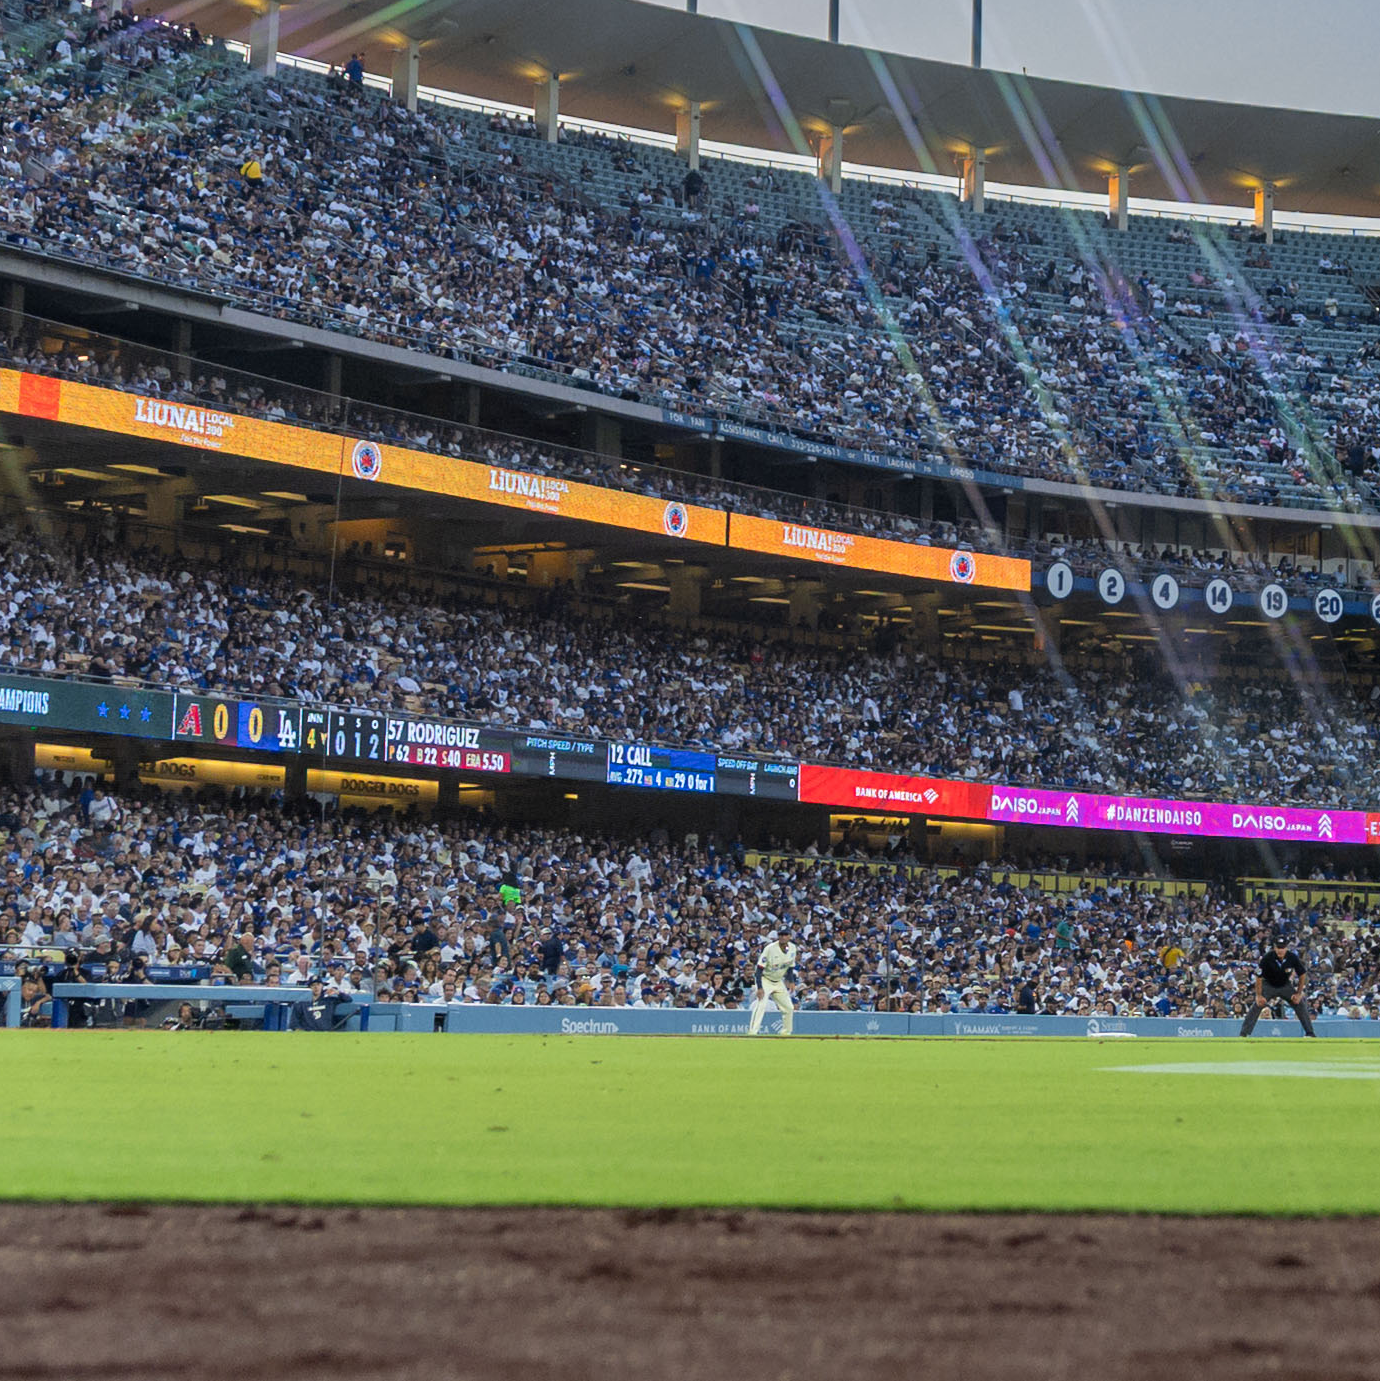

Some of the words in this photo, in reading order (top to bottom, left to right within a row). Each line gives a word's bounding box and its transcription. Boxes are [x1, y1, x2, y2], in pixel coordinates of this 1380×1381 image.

[134, 399, 206, 435] LiUNA!
[206, 412, 235, 428] LOCAL
[1056, 571, 1064, 591] 1
[1106, 576, 1118, 596] 2
[1159, 581, 1171, 601] 4
[1210, 587, 1228, 607] 14
[1265, 590, 1284, 611] 19
[1318, 596, 1340, 616] 20
[214, 703, 229, 740] 0
[248, 707, 263, 743] 0
[277, 710, 296, 748] LA
[388, 720, 404, 740] 57
[407, 723, 480, 748] RODRIGUEZ
[306, 728, 316, 749] 4
[335, 731, 346, 755] 0
[355, 732, 362, 757] 1
[369, 734, 380, 759] 2
[526, 737, 548, 749] PITCH
[548, 739, 571, 751] SPEED
[577, 742, 594, 753] TYPE
[389, 746, 395, 759] P
[396, 746, 410, 762] 62
[424, 748, 437, 764] 22
[448, 750, 461, 767] 40
[466, 753, 481, 768] ERA
[482, 753, 504, 771] 5.50
[610, 744, 624, 764] 12
[626, 746, 652, 767] CALL
[717, 757, 736, 769] SPEED
[160, 761, 196, 778] DOGS
[341, 778, 386, 793] DODGER
[388, 783, 419, 796] DOGS
[623, 768, 643, 785] .272
[655, 771, 662, 787] 4
[674, 773, 686, 789] 29
[687, 774, 694, 790] 0
[709, 776, 714, 792] 1
[855, 786, 877, 799] BANK
[877, 788, 887, 800] OF
[887, 790, 922, 803] AMERICA
[1038, 807, 1061, 817] JAPAN
[1106, 804, 1202, 827] #DANZENDAISO
[1286, 823, 1312, 832] JAPAN
[561, 1017, 615, 1035] Spectrum
[691, 1024, 717, 1033] BANK
[718, 1024, 730, 1033] OF
[1177, 1026, 1214, 1037] Spectrum
